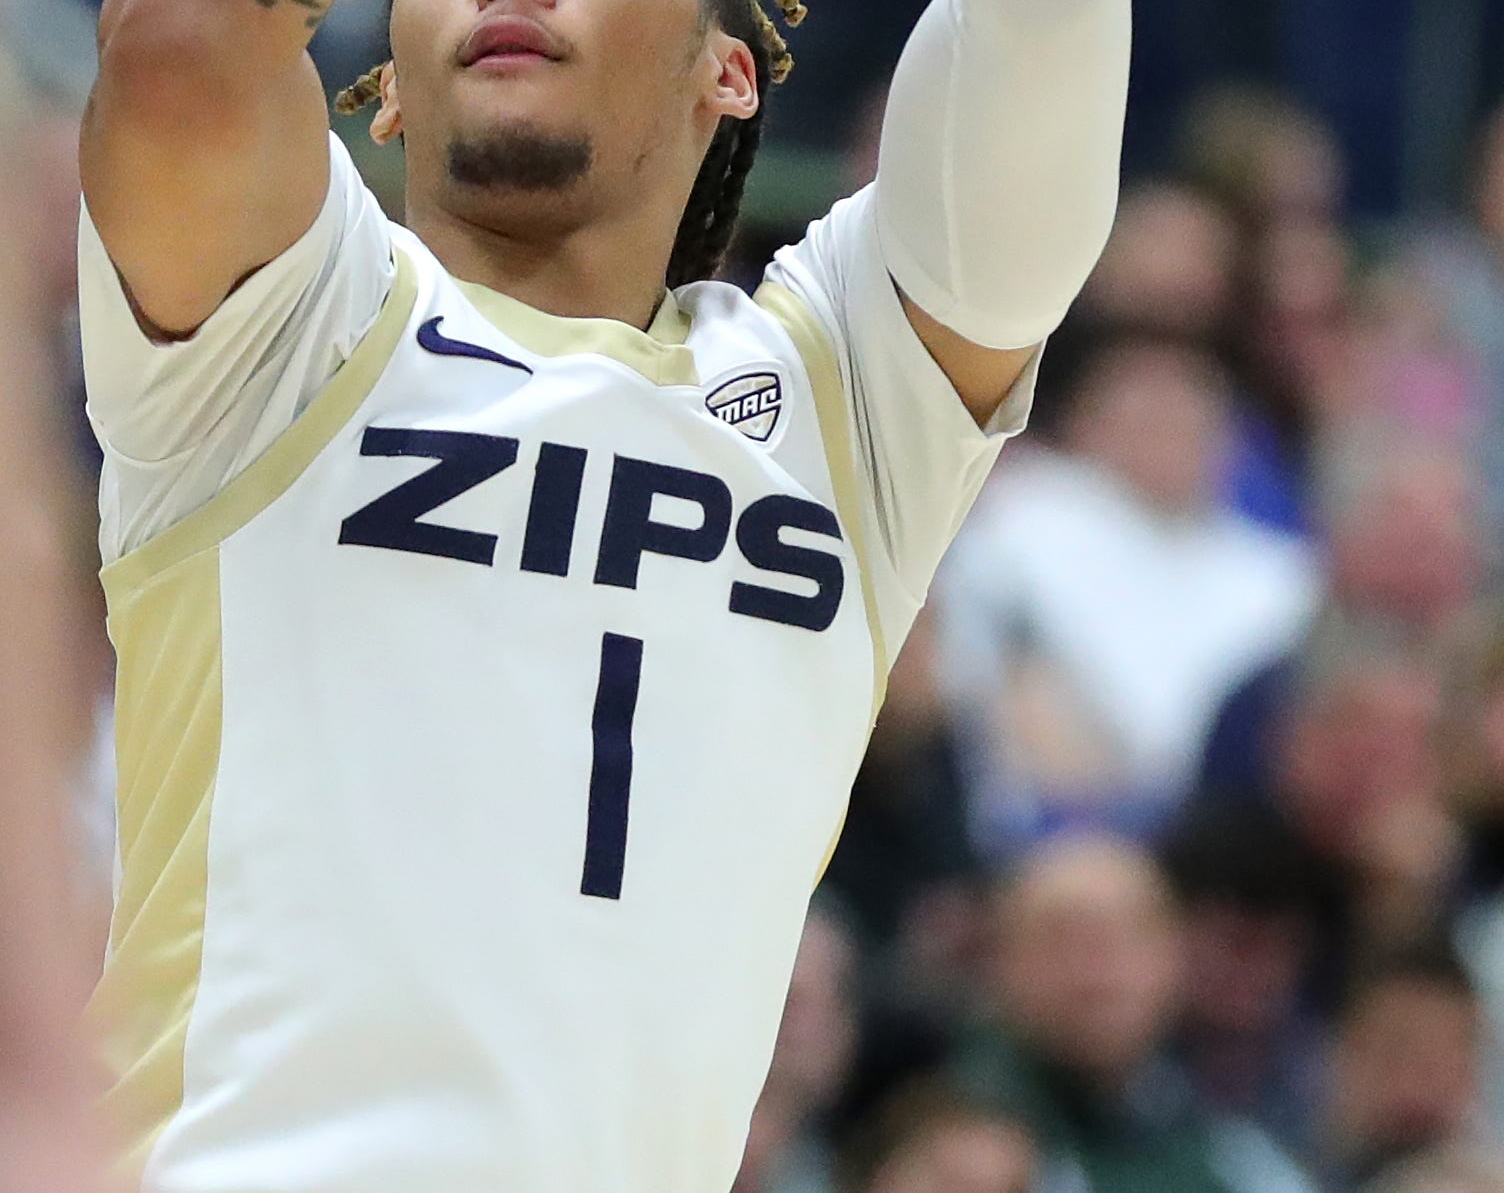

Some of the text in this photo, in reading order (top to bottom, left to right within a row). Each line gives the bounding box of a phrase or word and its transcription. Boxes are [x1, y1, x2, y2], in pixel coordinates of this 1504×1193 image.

[715, 386, 782, 424] MAC
[338, 426, 844, 632] ZIPS
[580, 631, 643, 900] 1
